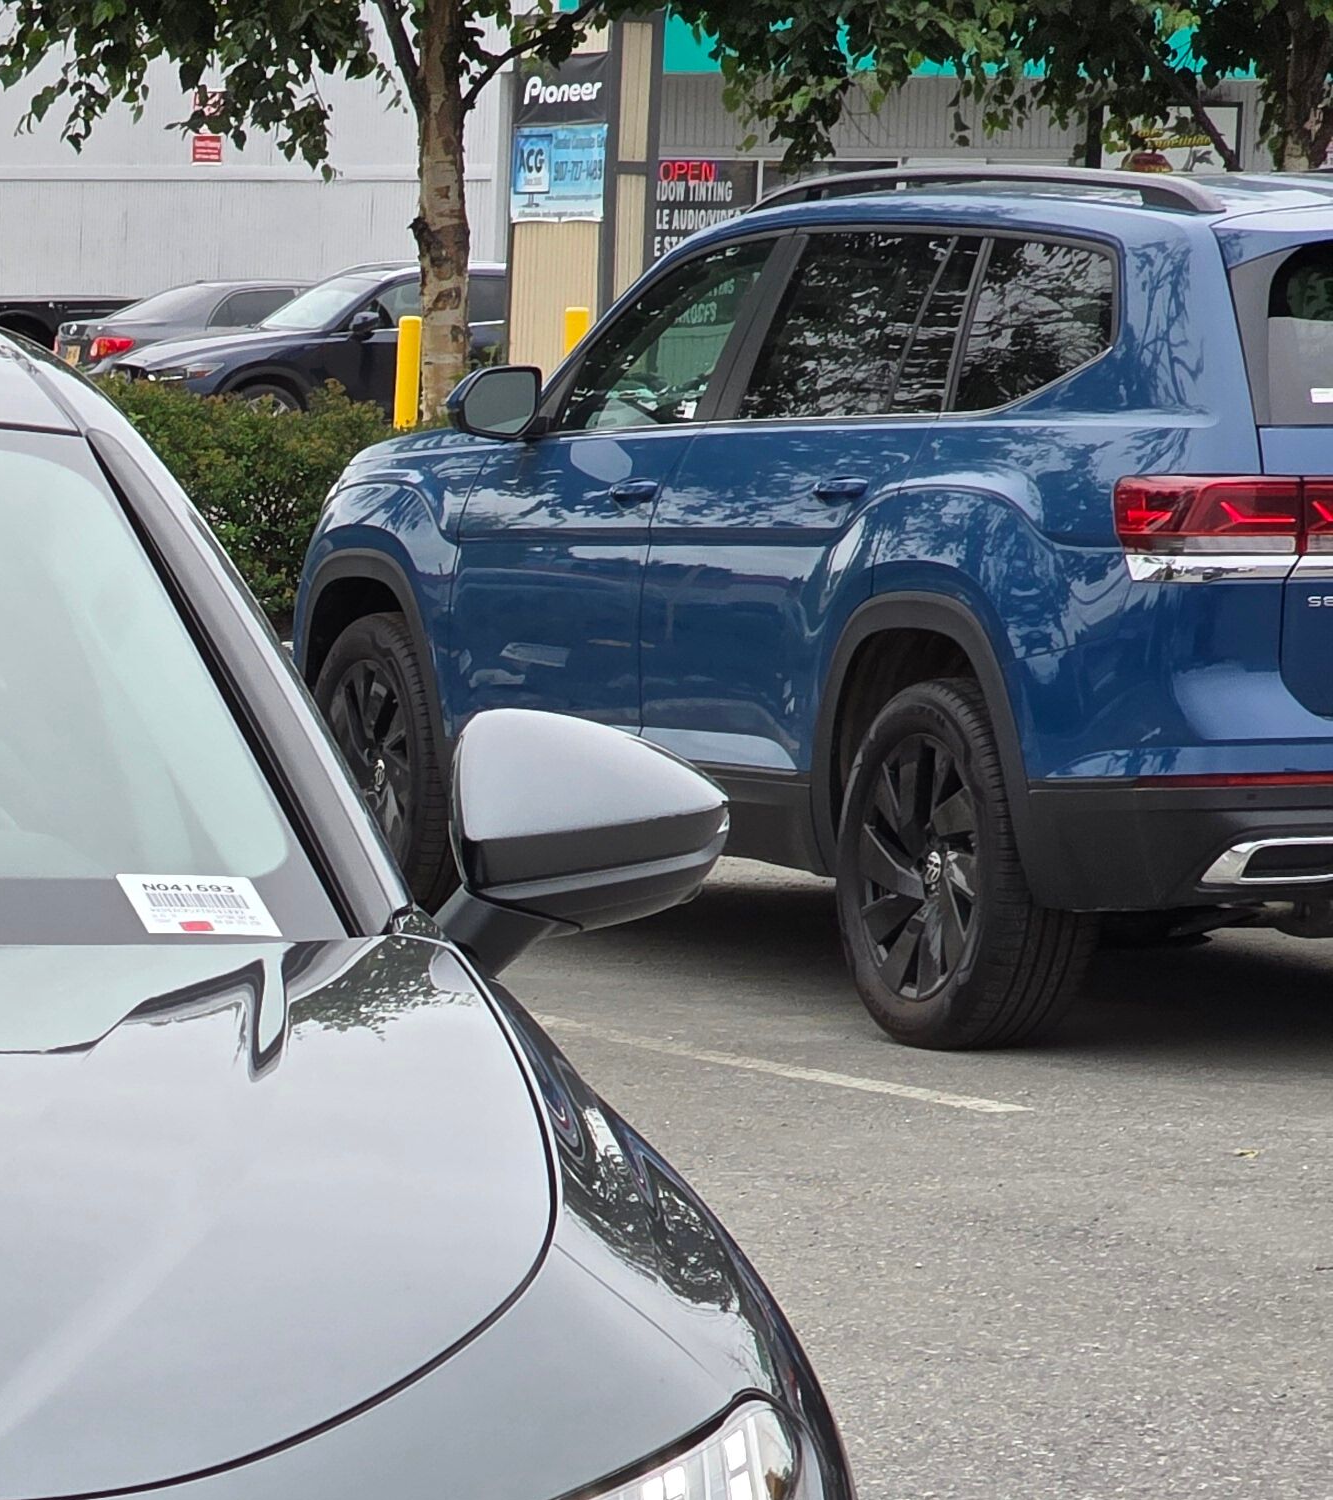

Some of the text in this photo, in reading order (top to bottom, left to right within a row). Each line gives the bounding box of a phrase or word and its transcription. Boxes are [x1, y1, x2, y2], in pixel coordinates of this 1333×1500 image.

[523, 76, 602, 105] Pioneer
[519, 148, 545, 173] ACG
[659, 161, 716, 182] OPEN
[688, 181, 733, 202] TINTING
